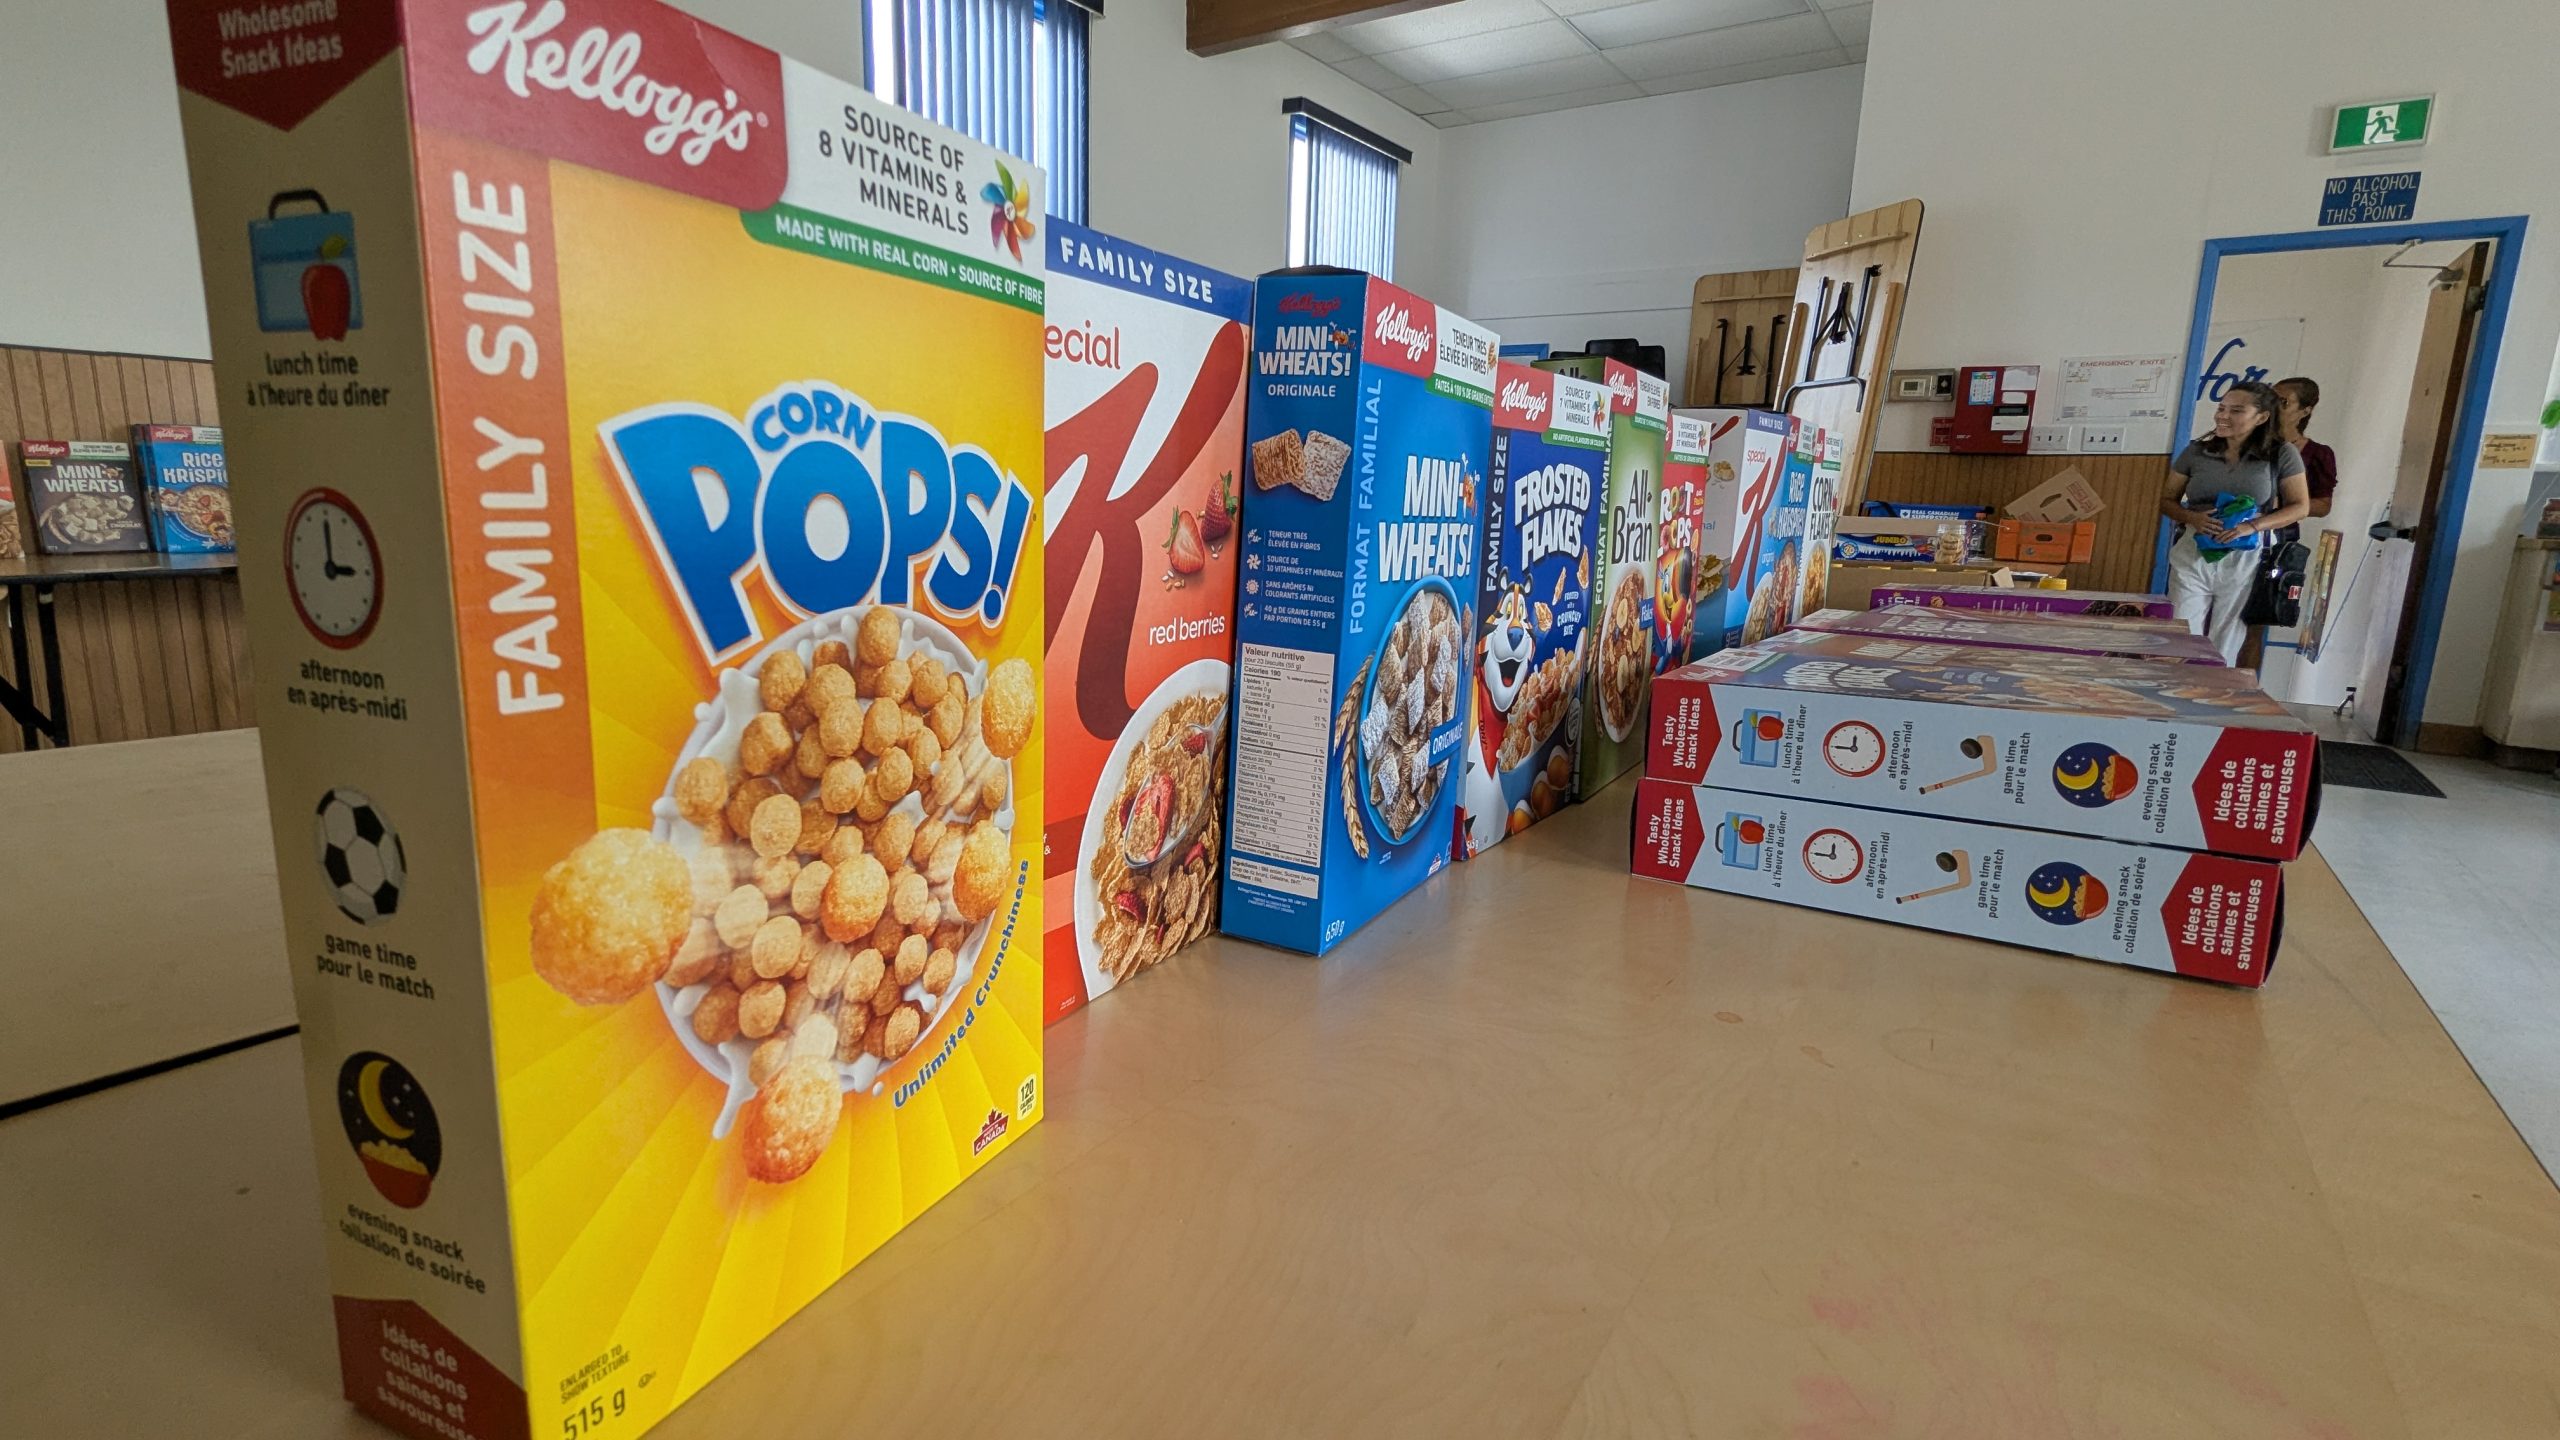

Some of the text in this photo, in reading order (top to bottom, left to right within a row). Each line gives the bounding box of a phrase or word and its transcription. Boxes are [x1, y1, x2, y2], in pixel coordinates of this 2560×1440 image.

[218, 0, 338, 40] Wholesome
[221, 36, 343, 78] Snack Ideas
[467, 0, 769, 166] Kellogg's
[844, 105, 964, 172] SOURCE OF
[819, 131, 967, 204] 8 VITAMINS &
[2328, 175, 2416, 194] NO ALCOHOL
[860, 178, 969, 234] MINERALS
[2327, 205, 2408, 224] THIS POINT.
[2351, 191, 2388, 207] PAST
[776, 216, 1043, 305] MADE WITH REAL CORN SOURCE OF FIBRE
[1061, 237, 1213, 303] FAMILY SIZE
[1044, 319, 1121, 370] ecial
[1375, 302, 1432, 362] Kellogg's
[1452, 328, 1473, 349] TENEUR
[266, 352, 358, 376] lunch time
[1259, 352, 1350, 376] WHEATS!
[1461, 355, 1469, 367] EN
[1470, 356, 1487, 376] FIBRES
[1268, 384, 1336, 397] ORIGINALE
[1501, 379, 1547, 421] Kellogg's
[1560, 397, 1563, 408] 7
[1564, 399, 1585, 412] VITAMINS
[1565, 386, 1584, 397] SOURCE
[452, 169, 565, 715] FAMILY SIZE
[751, 389, 876, 453] CORN
[1566, 413, 1590, 425] MINERALS
[1759, 416, 1783, 429] FAMILY SIZE
[1747, 448, 1766, 462] special
[44, 479, 124, 493] WHEATS!
[1350, 378, 1382, 634] FORMAT FAMILIAL
[1515, 464, 1590, 526] FROSTED
[1813, 477, 1833, 512] CORN
[597, 401, 1034, 667] POPS!
[1268, 530, 1291, 539] TENEUR
[1487, 435, 1507, 591] FAMILY SIZE
[1612, 506, 1652, 564] Bran
[1268, 540, 1289, 548] ÉLEVÉE
[1379, 521, 1473, 583] WHEATS!
[1522, 509, 1582, 571] FLAKES
[1595, 524, 1608, 605] FORMAT
[1873, 535, 1908, 544] JUMBO
[1148, 611, 1225, 645] red berries
[1245, 647, 1305, 661] Valeur nutritive
[301, 660, 384, 690] afternoon
[1433, 722, 1463, 754] ORIGINALE
[1663, 715, 1676, 747] Tasty
[1673, 697, 1689, 767] Wholesome
[1686, 697, 1701, 769] Snack Ideas
[1796, 730, 1804, 741] du
[1797, 704, 1807, 728] dîner
[1782, 718, 1795, 768] lunch time
[1793, 743, 1803, 775] l'heure
[1888, 730, 1901, 779] afternoon
[1899, 721, 1914, 790] en après-midi
[2004, 739, 2016, 794] game time
[2015, 732, 2030, 804] pour le match
[2143, 743, 2161, 821] evening snack
[2155, 733, 2178, 833] collation de soirée
[2213, 760, 2237, 822] Idées de
[2234, 757, 2257, 829] collations
[2254, 763, 2275, 830] saines et
[2271, 749, 2297, 844] savoureuses
[1647, 815, 1661, 844] Tasty
[1658, 798, 1673, 865] Wholesome
[1670, 799, 1684, 867] Snack Ideas
[1762, 823, 1775, 872] lunch time
[1866, 841, 1878, 888] afternoon
[1978, 855, 1991, 910] game time
[2112, 865, 2130, 941] evening snack
[2181, 886, 2204, 946] Idées de
[2203, 884, 2223, 953] collations
[2221, 891, 2242, 956] saines et
[2237, 879, 2263, 971] savoureuses
[325, 935, 416, 970] game time
[894, 860, 1029, 1108] Unlimited Crunchiness
[1021, 1079, 1033, 1101] 120
[976, 1123, 1005, 1151] CANADA
[348, 1205, 464, 1262] evening snack
[382, 1320, 457, 1371] Idées de
[560, 1344, 622, 1391] ENLARGED TO
[380, 1346, 468, 1401] collations
[561, 1351, 630, 1404] SHOW TEXTURE
[564, 1388, 625, 1440] 515 g
